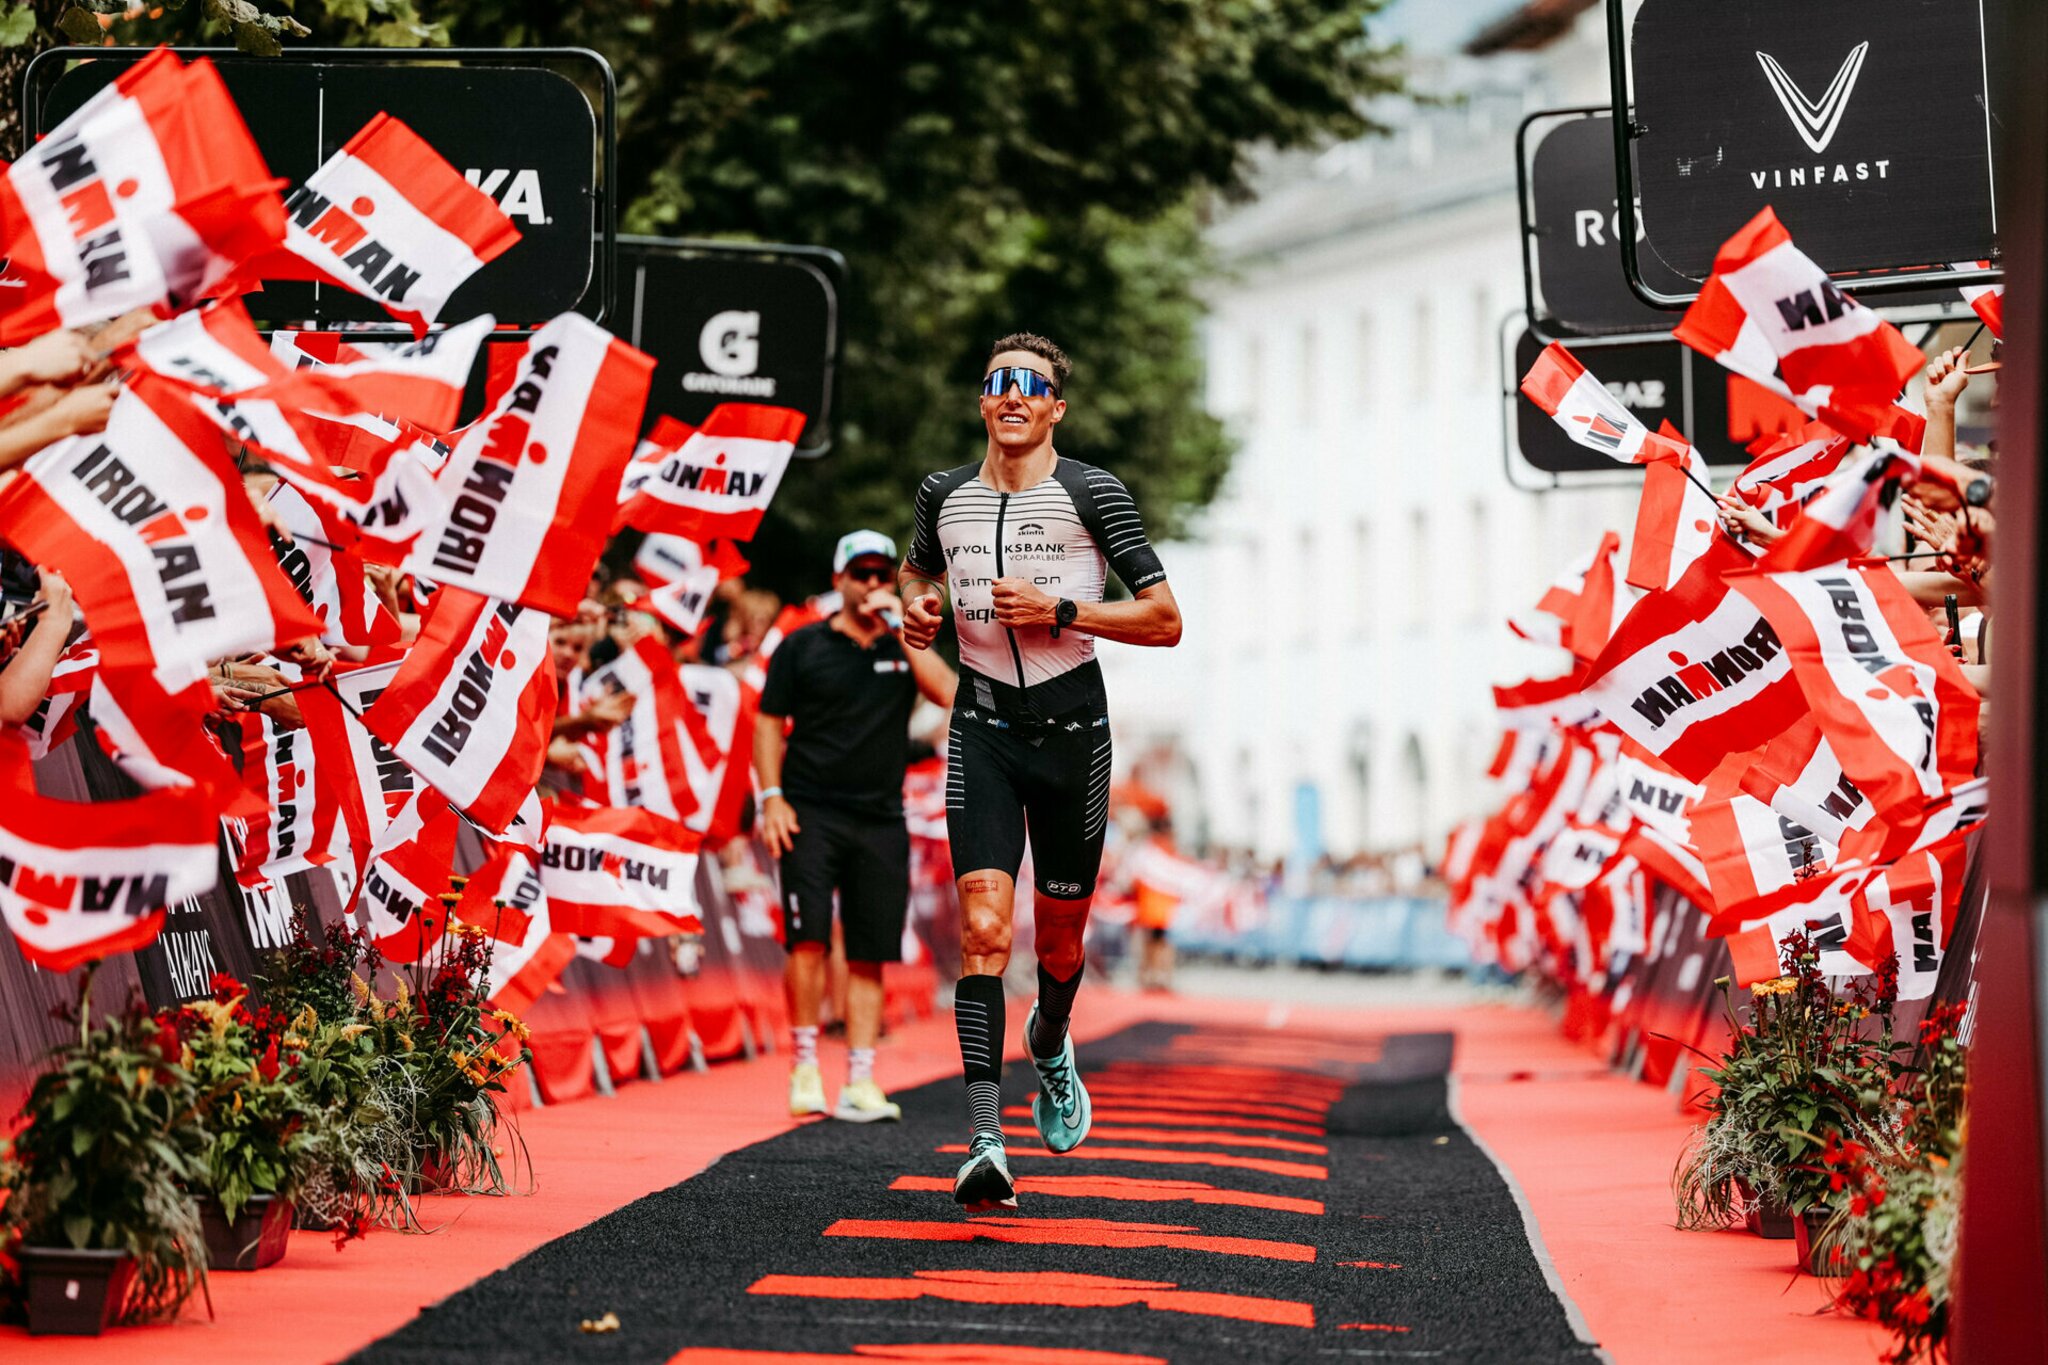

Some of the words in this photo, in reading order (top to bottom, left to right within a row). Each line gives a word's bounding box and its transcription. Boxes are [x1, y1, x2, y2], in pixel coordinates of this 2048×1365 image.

[1750, 159, 1890, 190] VINFAST
[71, 443, 216, 634] IRONMAN
[1017, 529, 1045, 537] skinfit
